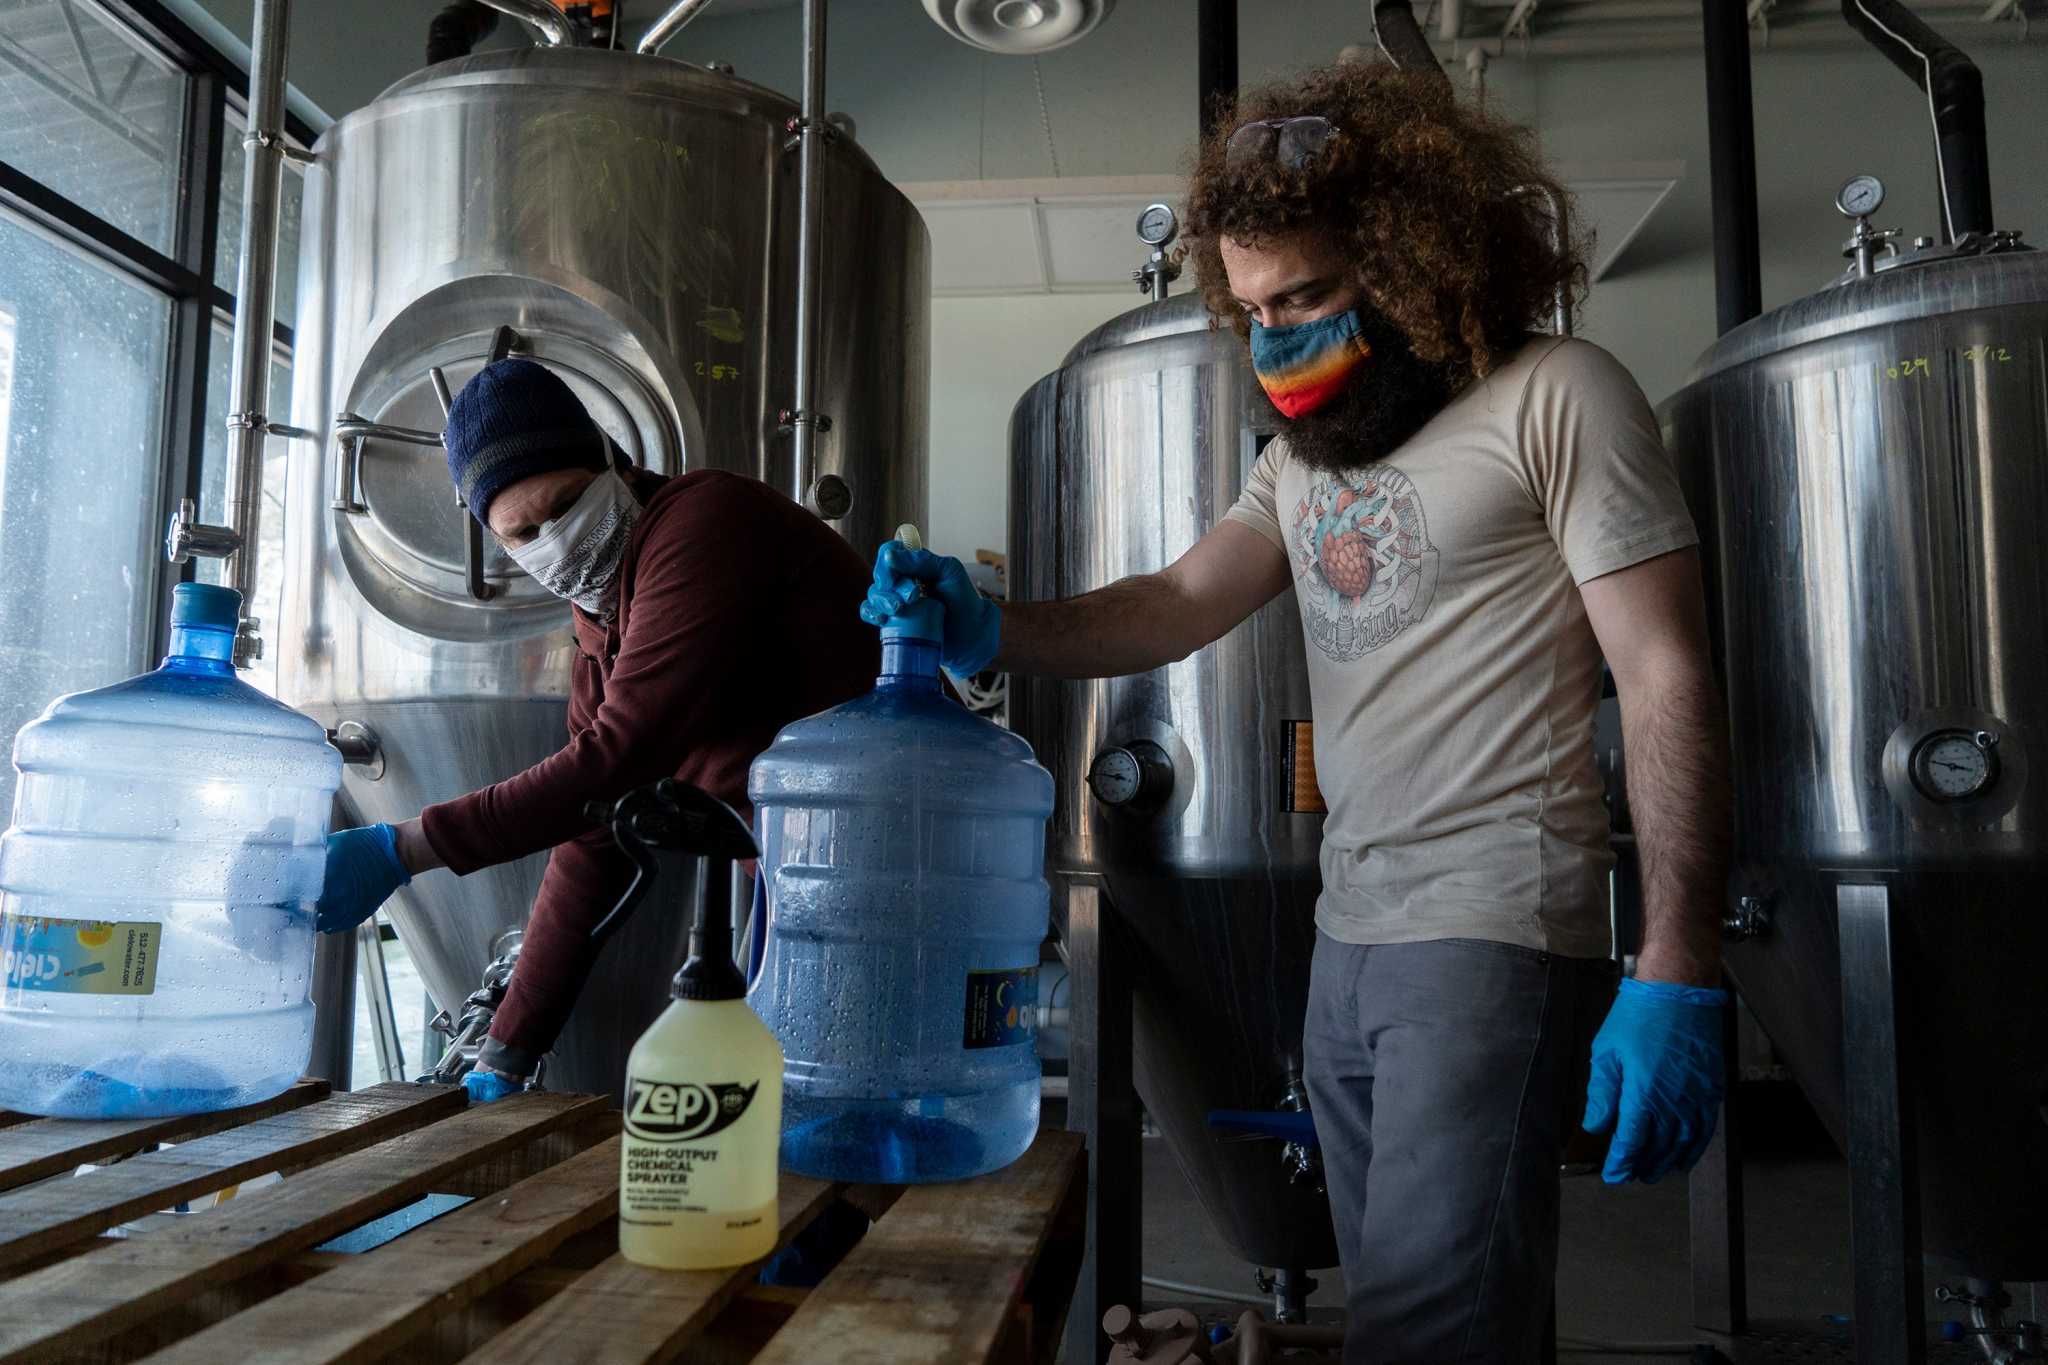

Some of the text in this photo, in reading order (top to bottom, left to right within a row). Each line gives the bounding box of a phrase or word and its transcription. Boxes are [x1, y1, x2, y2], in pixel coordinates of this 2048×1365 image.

[627, 1147, 719, 1161] HIGH-OUTPUT
[627, 1160, 694, 1172] CHEMICAL
[627, 1173, 688, 1184] SPRAYER
